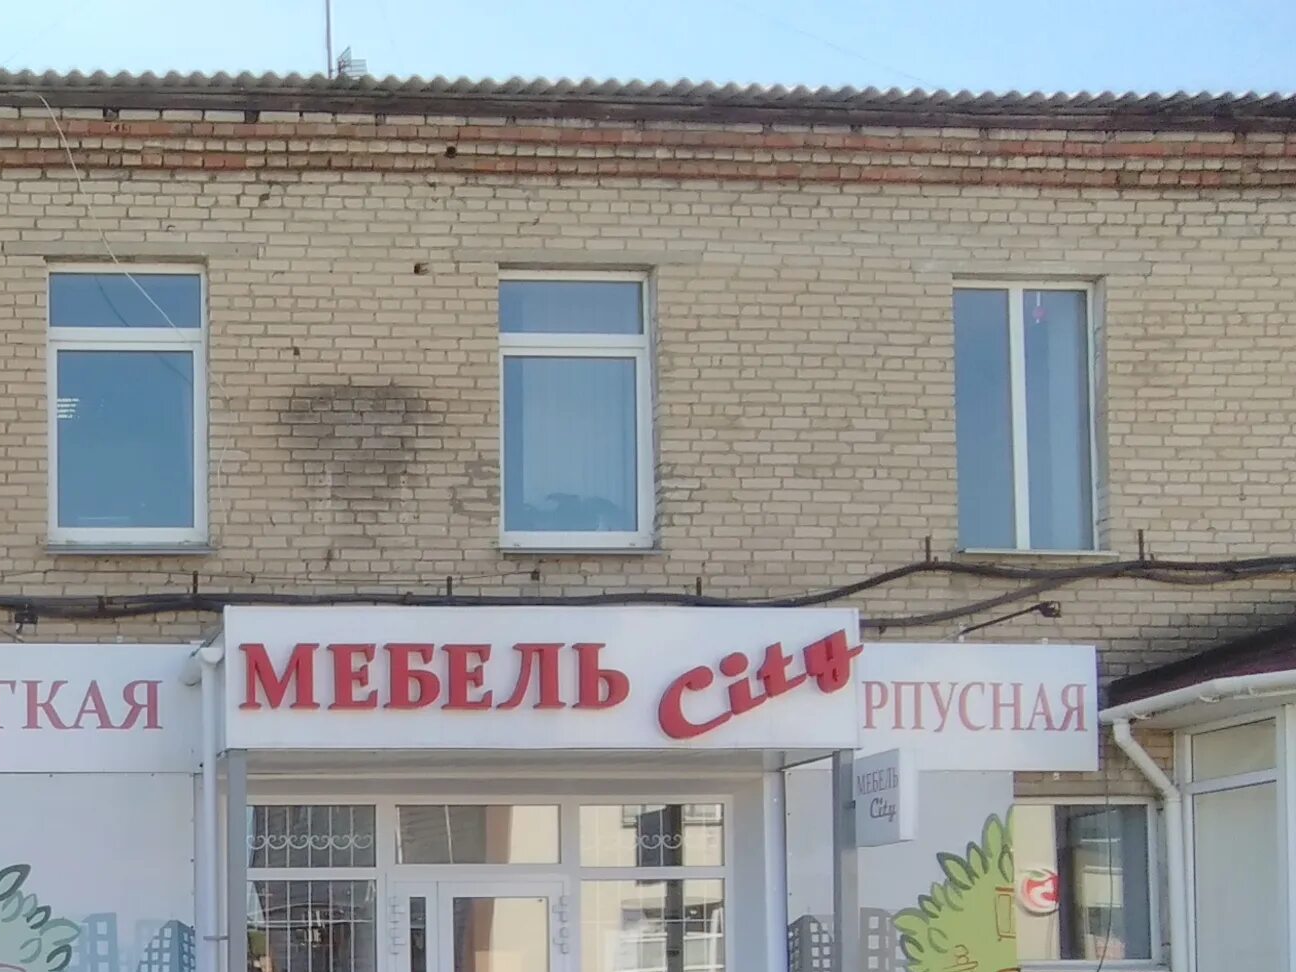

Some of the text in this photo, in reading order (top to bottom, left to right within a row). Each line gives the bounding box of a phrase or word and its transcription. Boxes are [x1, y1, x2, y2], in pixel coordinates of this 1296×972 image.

[238, 628, 865, 740] МЕБЕЛЬ City
[861, 680, 1089, 733] РПУСНАЯ
[856, 767, 900, 795] МЕБЕЛЬ
[869, 797, 897, 823] City
